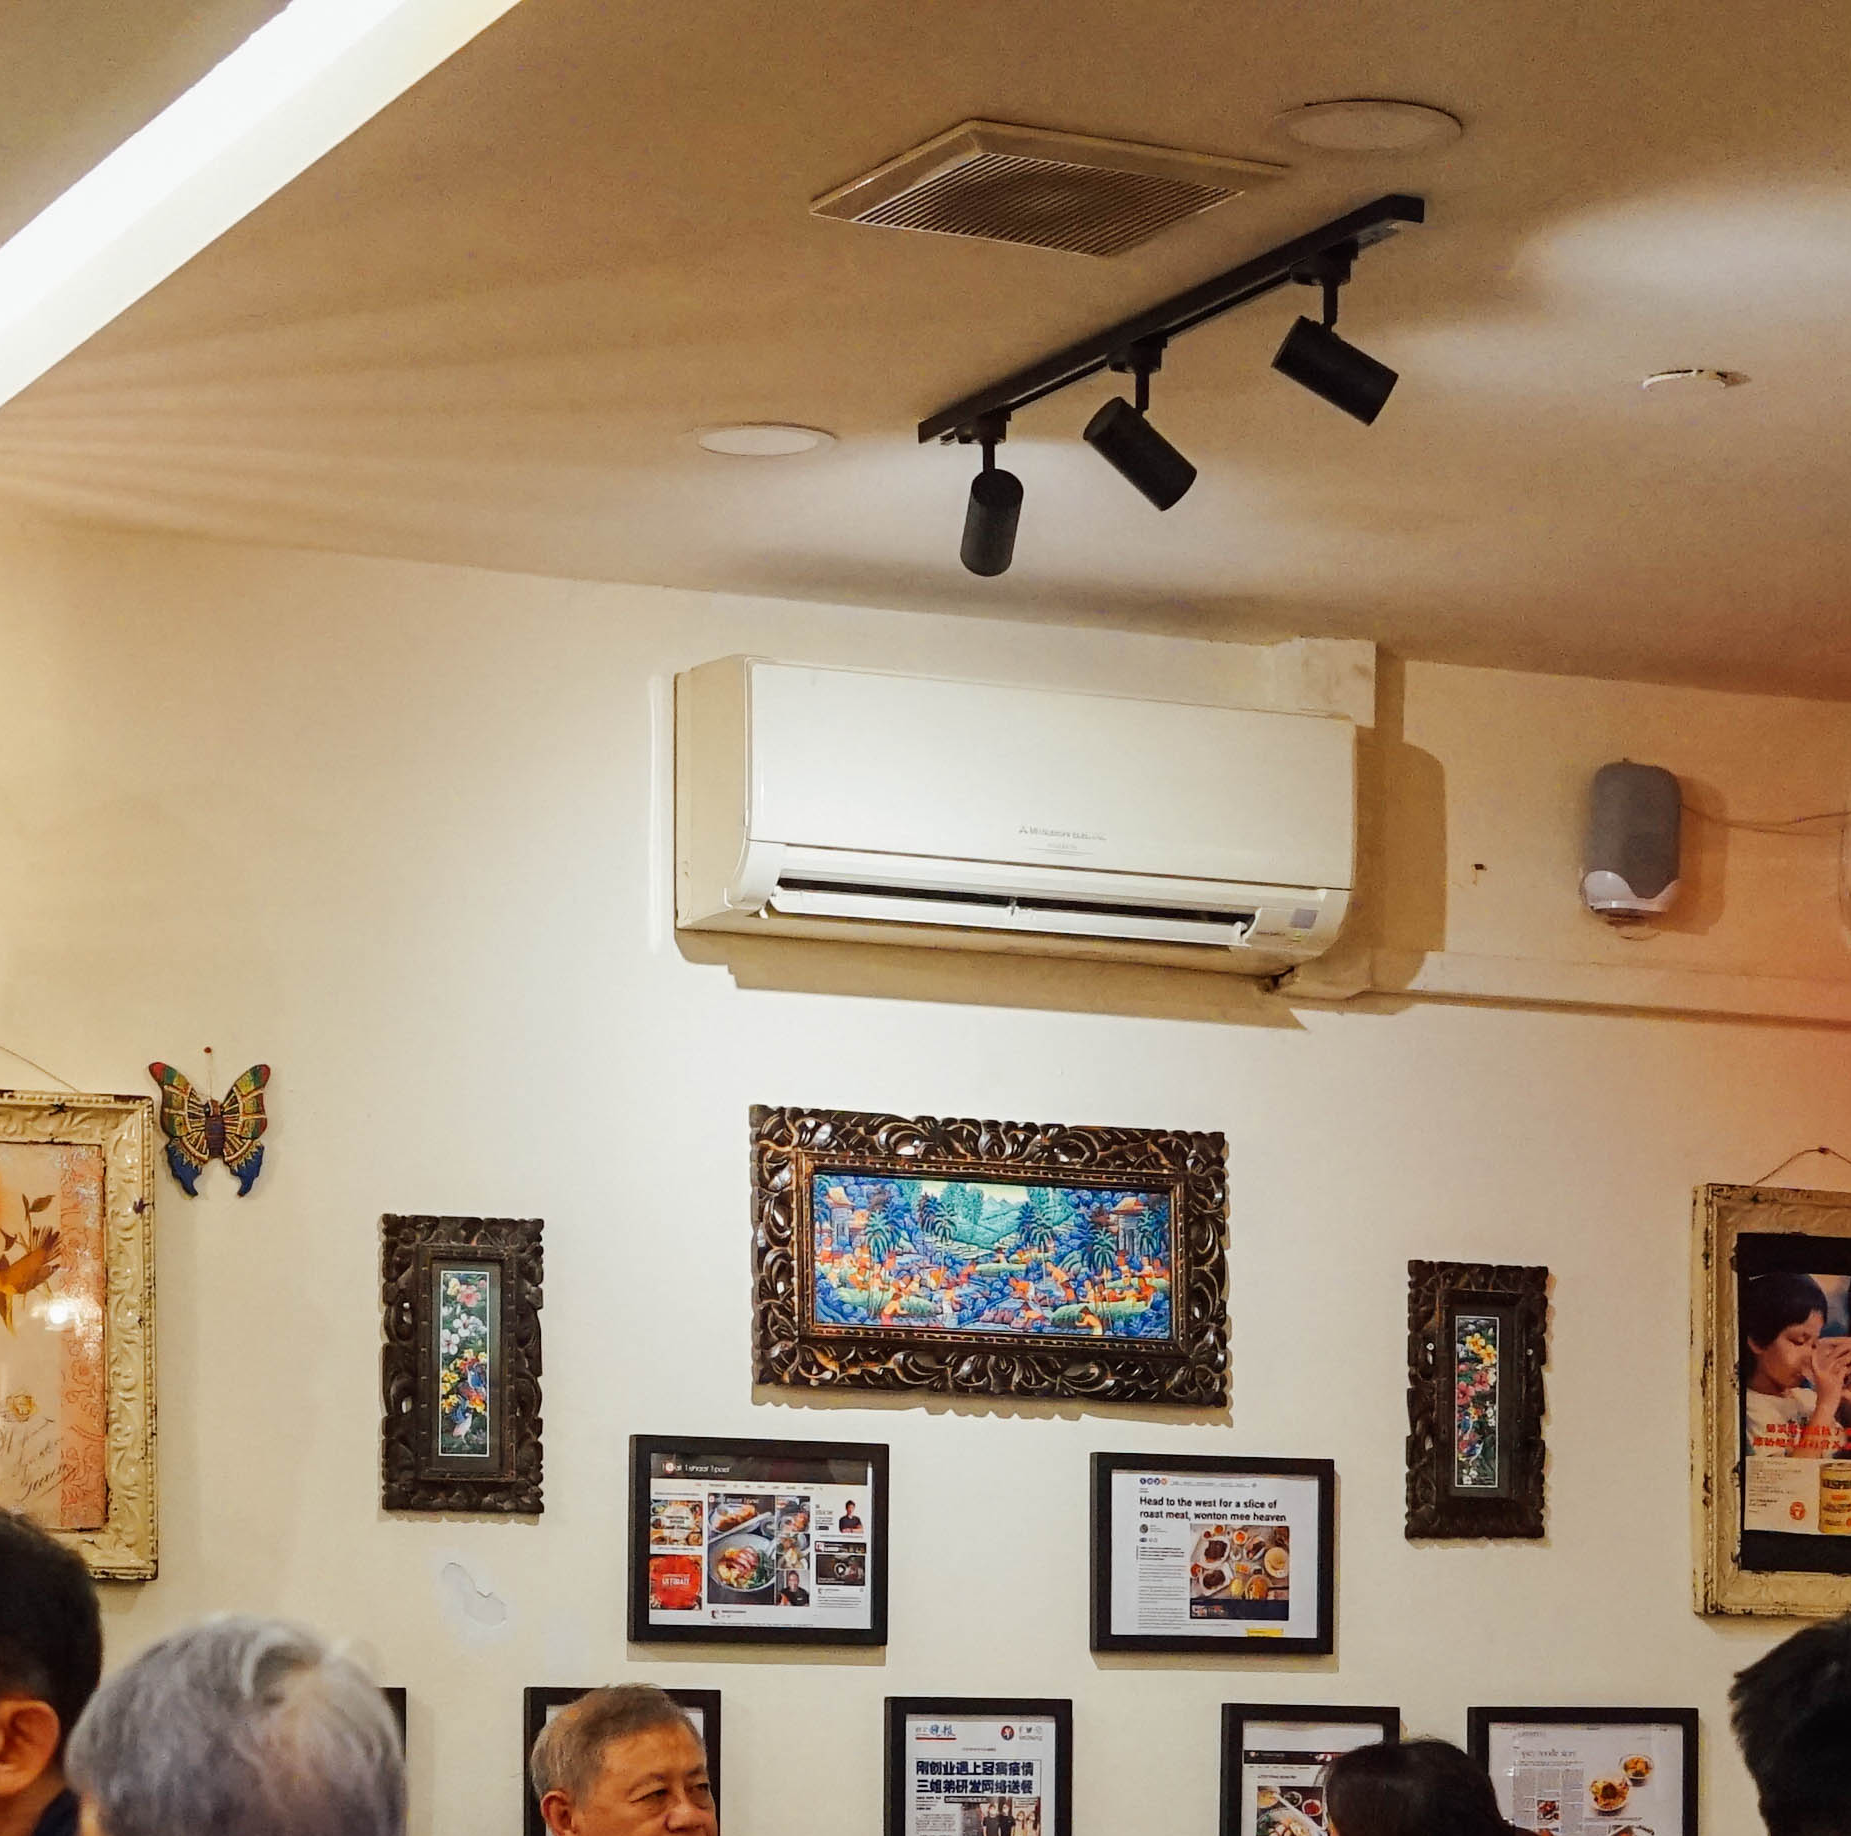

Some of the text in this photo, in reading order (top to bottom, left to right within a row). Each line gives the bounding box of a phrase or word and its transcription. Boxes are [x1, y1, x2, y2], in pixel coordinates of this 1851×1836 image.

[1139, 1496, 1164, 1506] Head
[1165, 1498, 1176, 1506] to
[1177, 1497, 1192, 1507] the
[1194, 1498, 1217, 1508] west
[1219, 1498, 1232, 1508] for
[1244, 1499, 1265, 1509] slice
[1267, 1500, 1277, 1509] of
[1139, 1510, 1287, 1522] roast meat, wonton mee heaven
